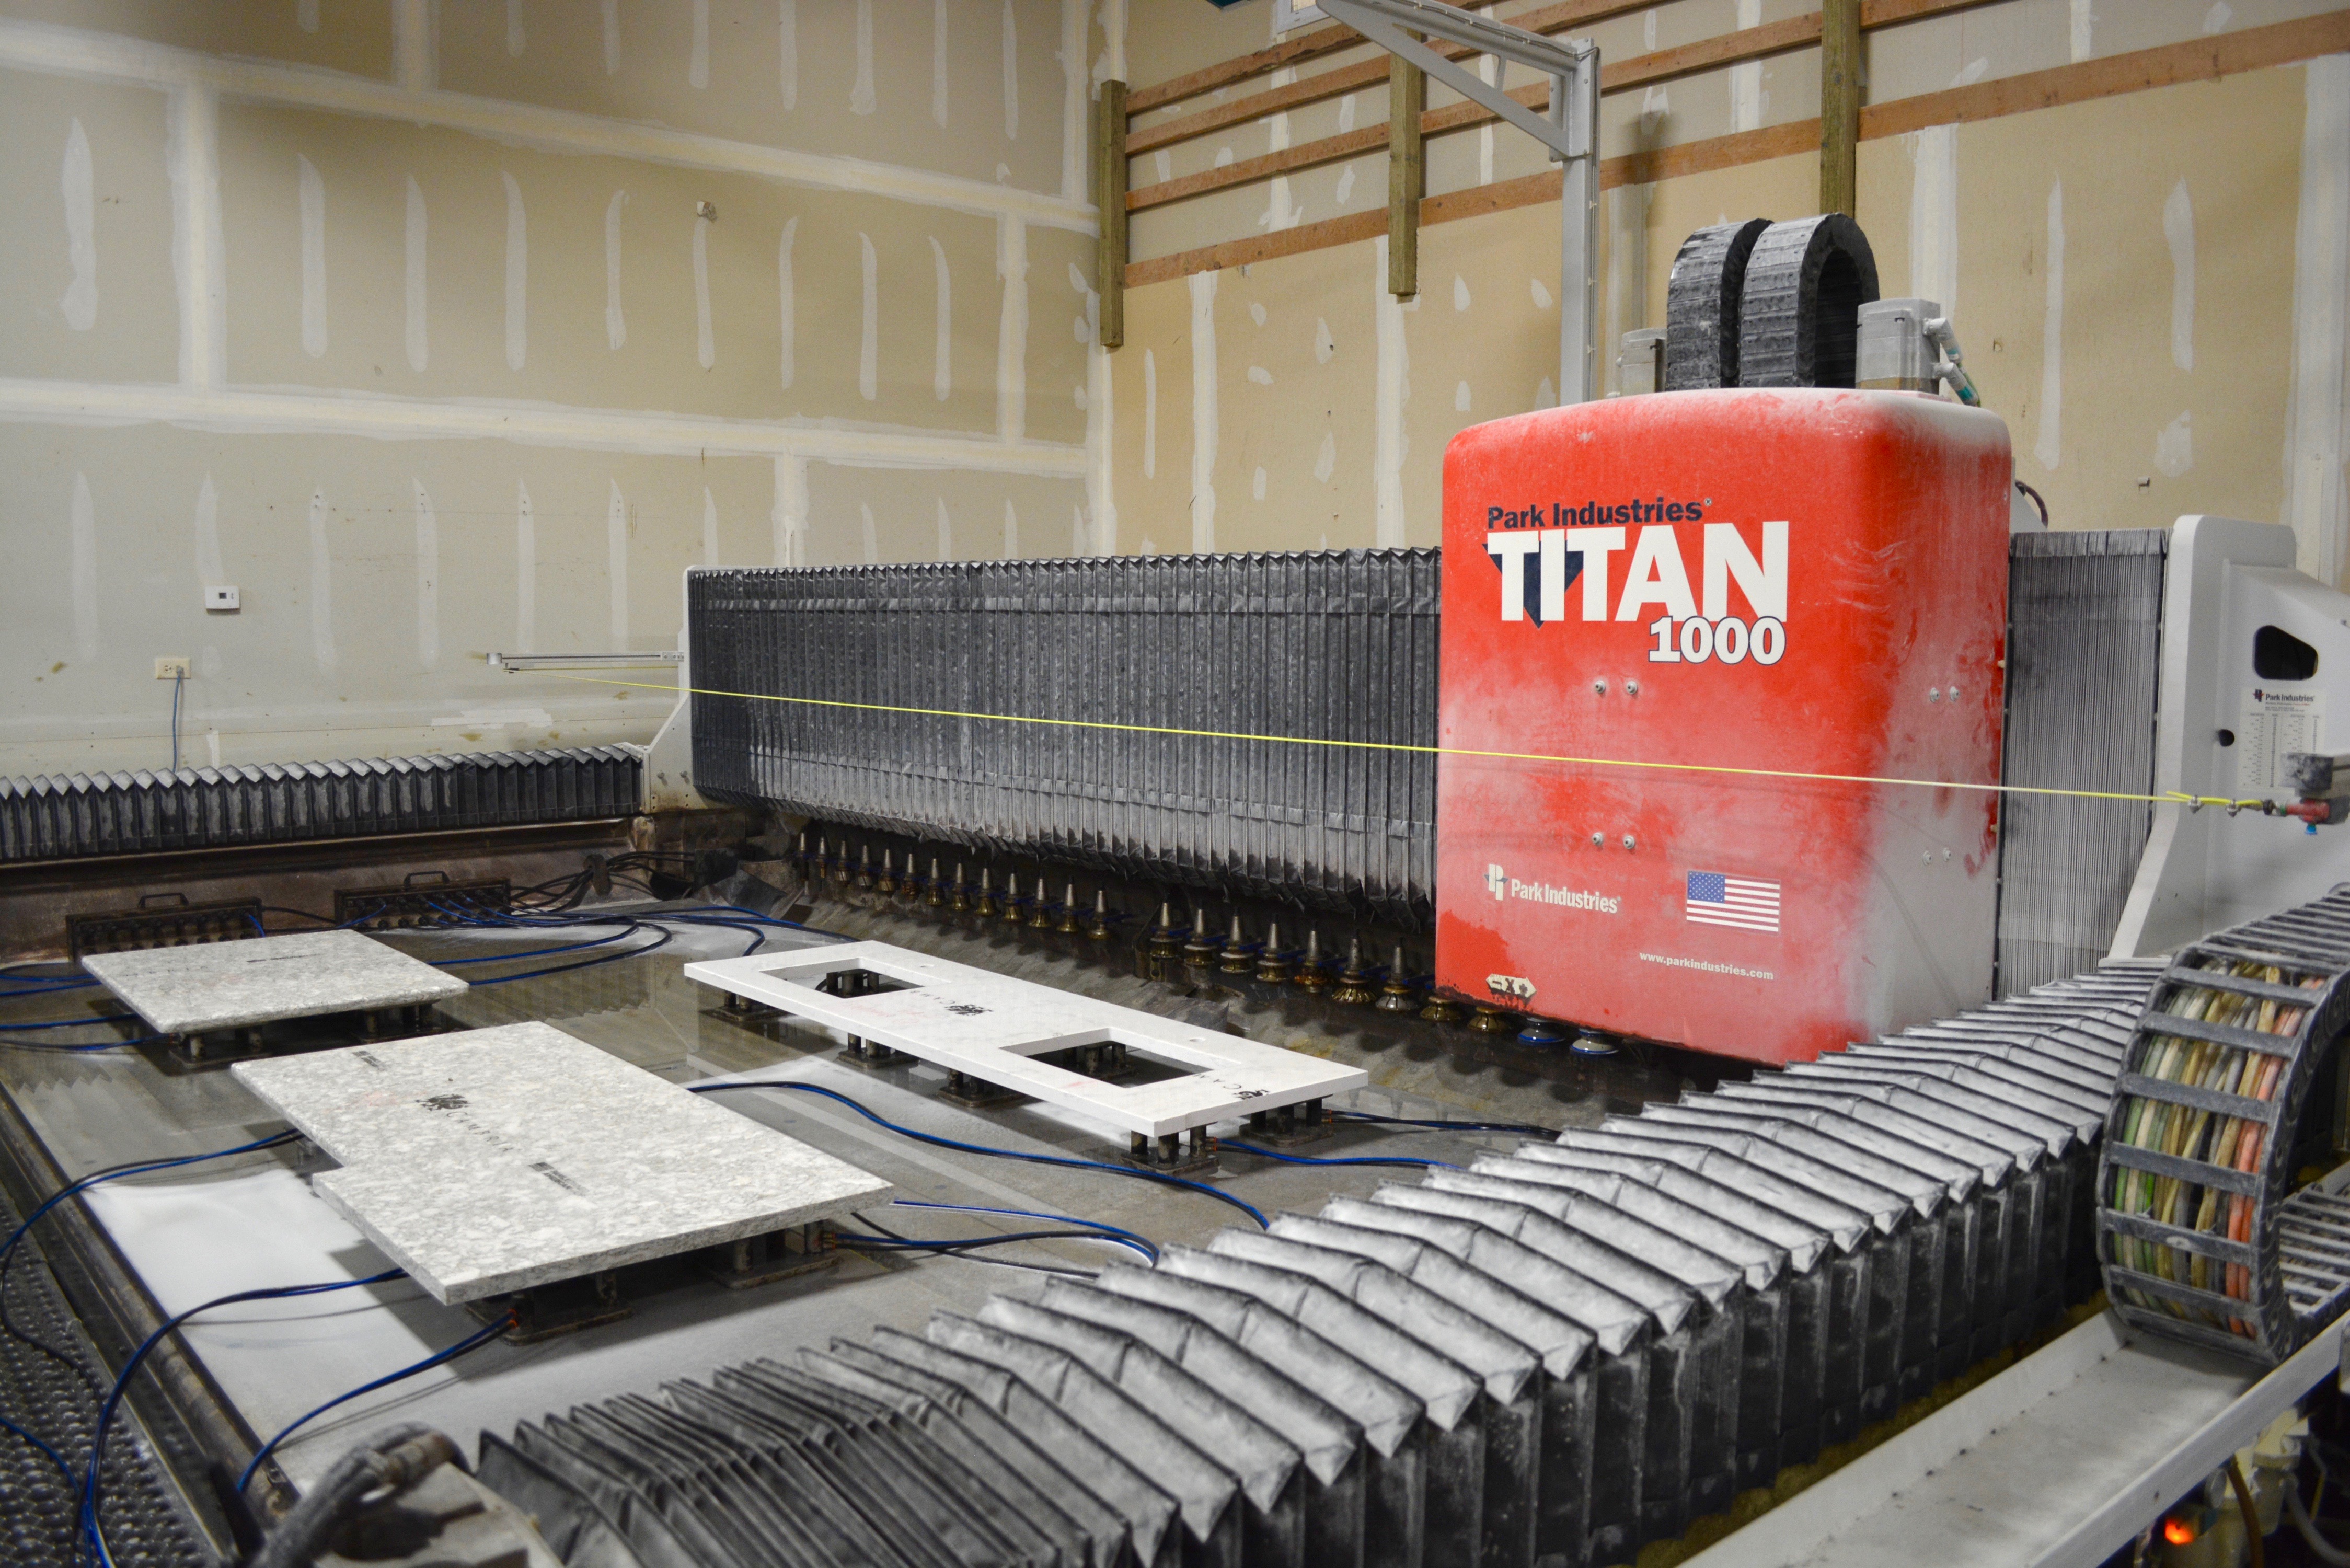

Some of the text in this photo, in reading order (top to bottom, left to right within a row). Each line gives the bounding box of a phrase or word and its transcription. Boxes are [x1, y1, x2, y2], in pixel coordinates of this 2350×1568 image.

[1488, 505, 1544, 529] Park
[1487, 521, 1789, 622] TITAN
[1648, 615, 1787, 665] 1000
[1511, 879, 1543, 902] Park
[1639, 952, 1774, 981] www.parkindustries.com
